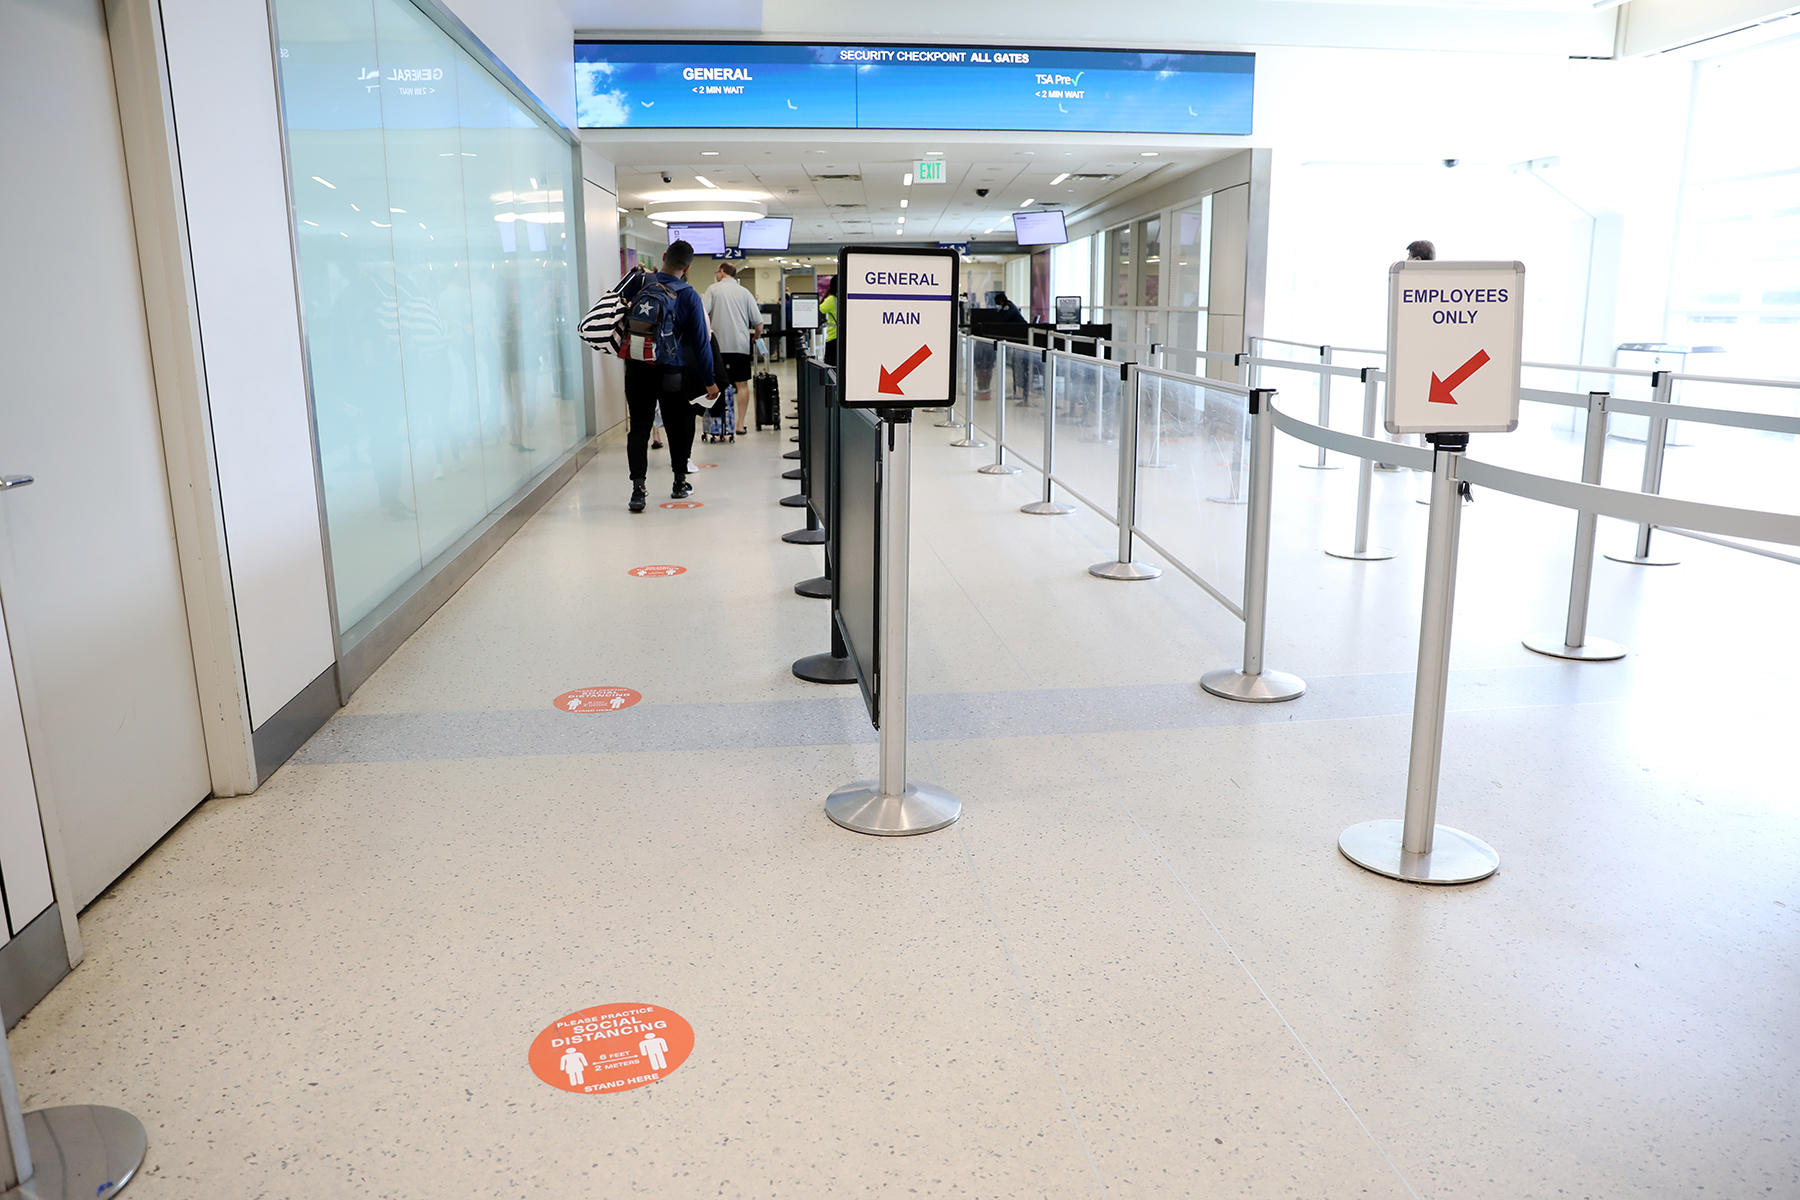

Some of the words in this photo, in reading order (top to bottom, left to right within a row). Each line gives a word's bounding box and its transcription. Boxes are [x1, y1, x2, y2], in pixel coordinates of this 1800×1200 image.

[840, 50, 895, 61] SECURITY
[896, 51, 967, 62] CHECKPOINT
[970, 52, 992, 63] ALL
[993, 53, 1030, 64] GATES
[683, 67, 753, 81] GENERAL
[1035, 74, 1054, 85] TSA
[1055, 74, 1071, 85] Pre
[698, 86, 705, 94] 2
[706, 86, 722, 94] MIN
[723, 86, 745, 94] WAIT
[1041, 90, 1048, 98] 2
[1048, 90, 1064, 98] MIN
[1064, 91, 1085, 99] WAIT
[920, 162, 941, 180] EXIT
[865, 271, 939, 286] GENERAL
[1403, 289, 1509, 303] EMPLOYEES
[882, 312, 920, 325] MAIN
[1432, 310, 1479, 324] ONLY
[556, 1016, 599, 1028] PLEASE
[600, 1007, 655, 1021] PRACTICE
[573, 1016, 642, 1034] SOCIAL
[551, 1020, 668, 1048] DISTANCING
[599, 1053, 608, 1061] 6
[608, 1050, 631, 1059] FEET
[604, 1059, 641, 1070] METERS
[584, 1079, 625, 1093] STAND
[627, 1072, 660, 1085] HERE
